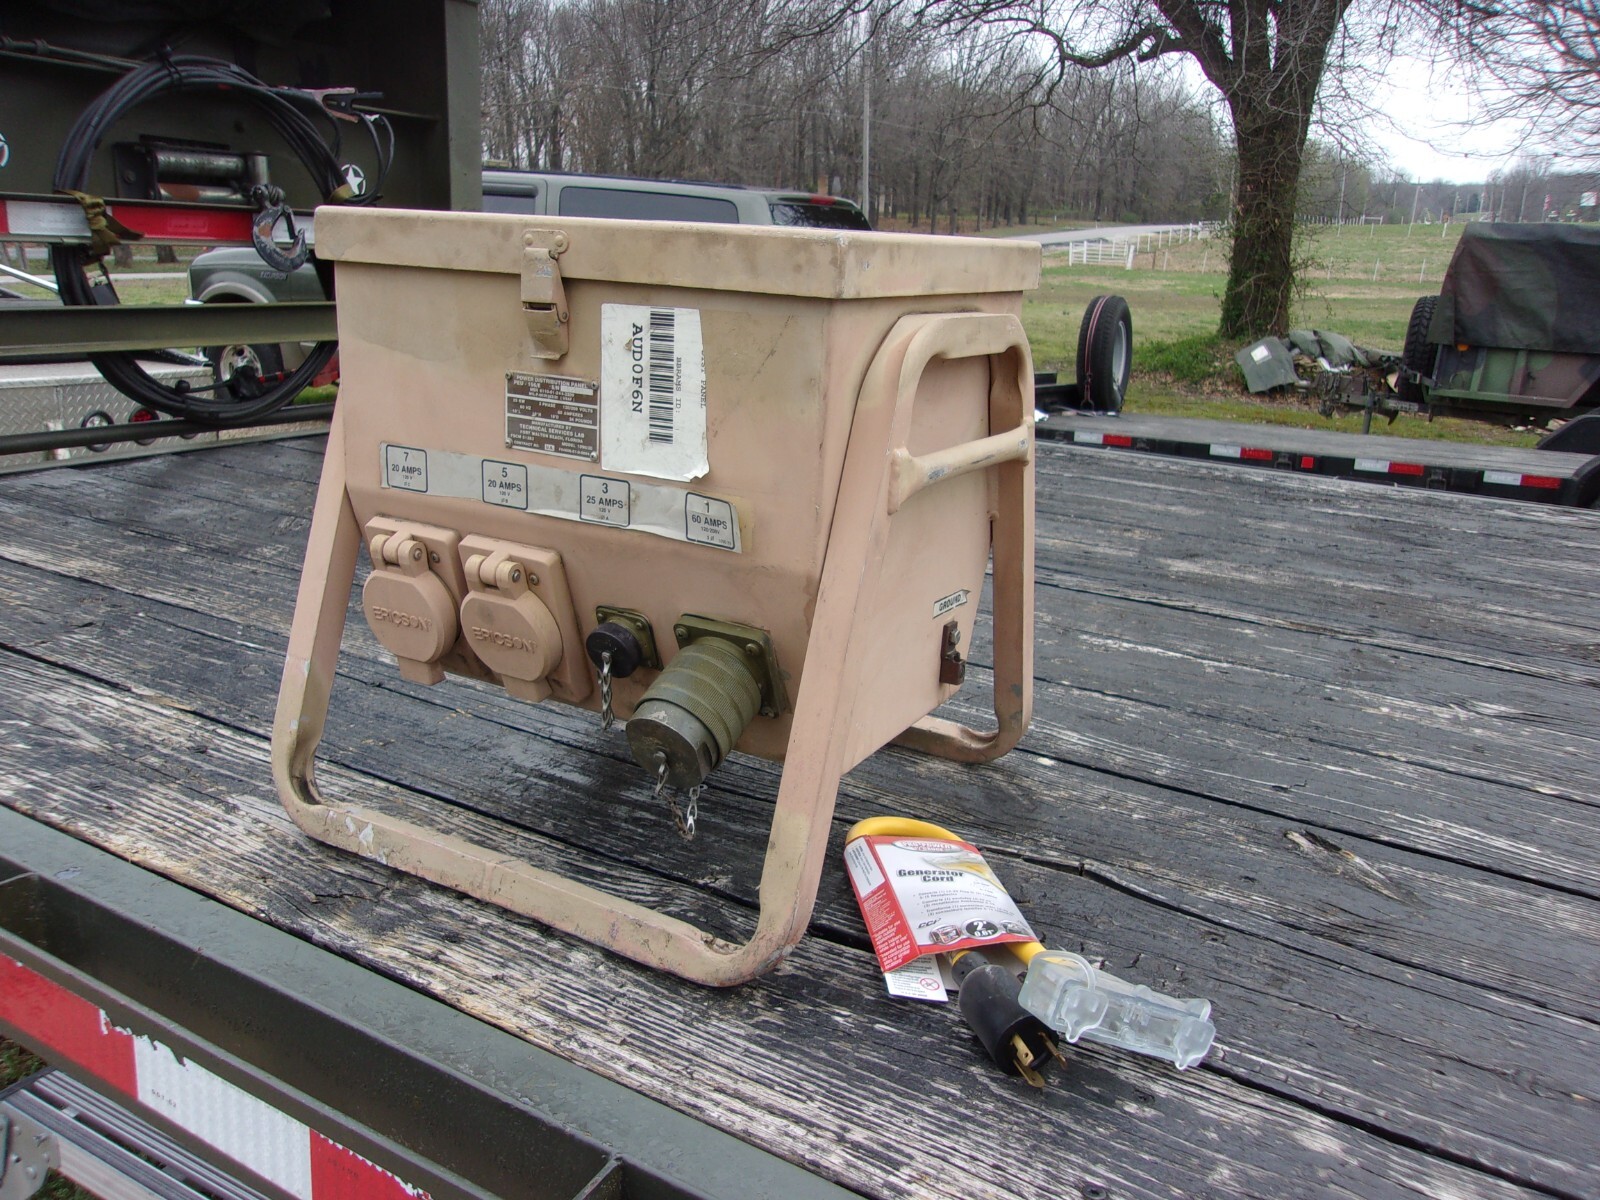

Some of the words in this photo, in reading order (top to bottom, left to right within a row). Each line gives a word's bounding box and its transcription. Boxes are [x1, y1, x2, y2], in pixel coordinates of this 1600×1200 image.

[570, 380, 588, 389] PANEL
[519, 423, 547, 432] TECHNICAL
[548, 428, 573, 437] SERVICES
[564, 436, 583, 444] FLORIDA
[403, 451, 409, 462] 7
[391, 464, 399, 472] 20
[401, 465, 422, 476] AMPS
[501, 467, 508, 478] 5
[487, 479, 497, 488] 20
[499, 480, 522, 492] AMPS
[602, 482, 609, 494] 3
[586, 495, 596, 504] 25
[598, 497, 624, 509] AMPS
[704, 501, 710, 513] 1
[691, 514, 702, 524] 60
[704, 516, 728, 530] AMPS
[938, 593, 962, 612] GROUND
[372, 605, 432, 632] ERICSON
[471, 626, 535, 653] ERICSON
[898, 869, 964, 877] Generator
